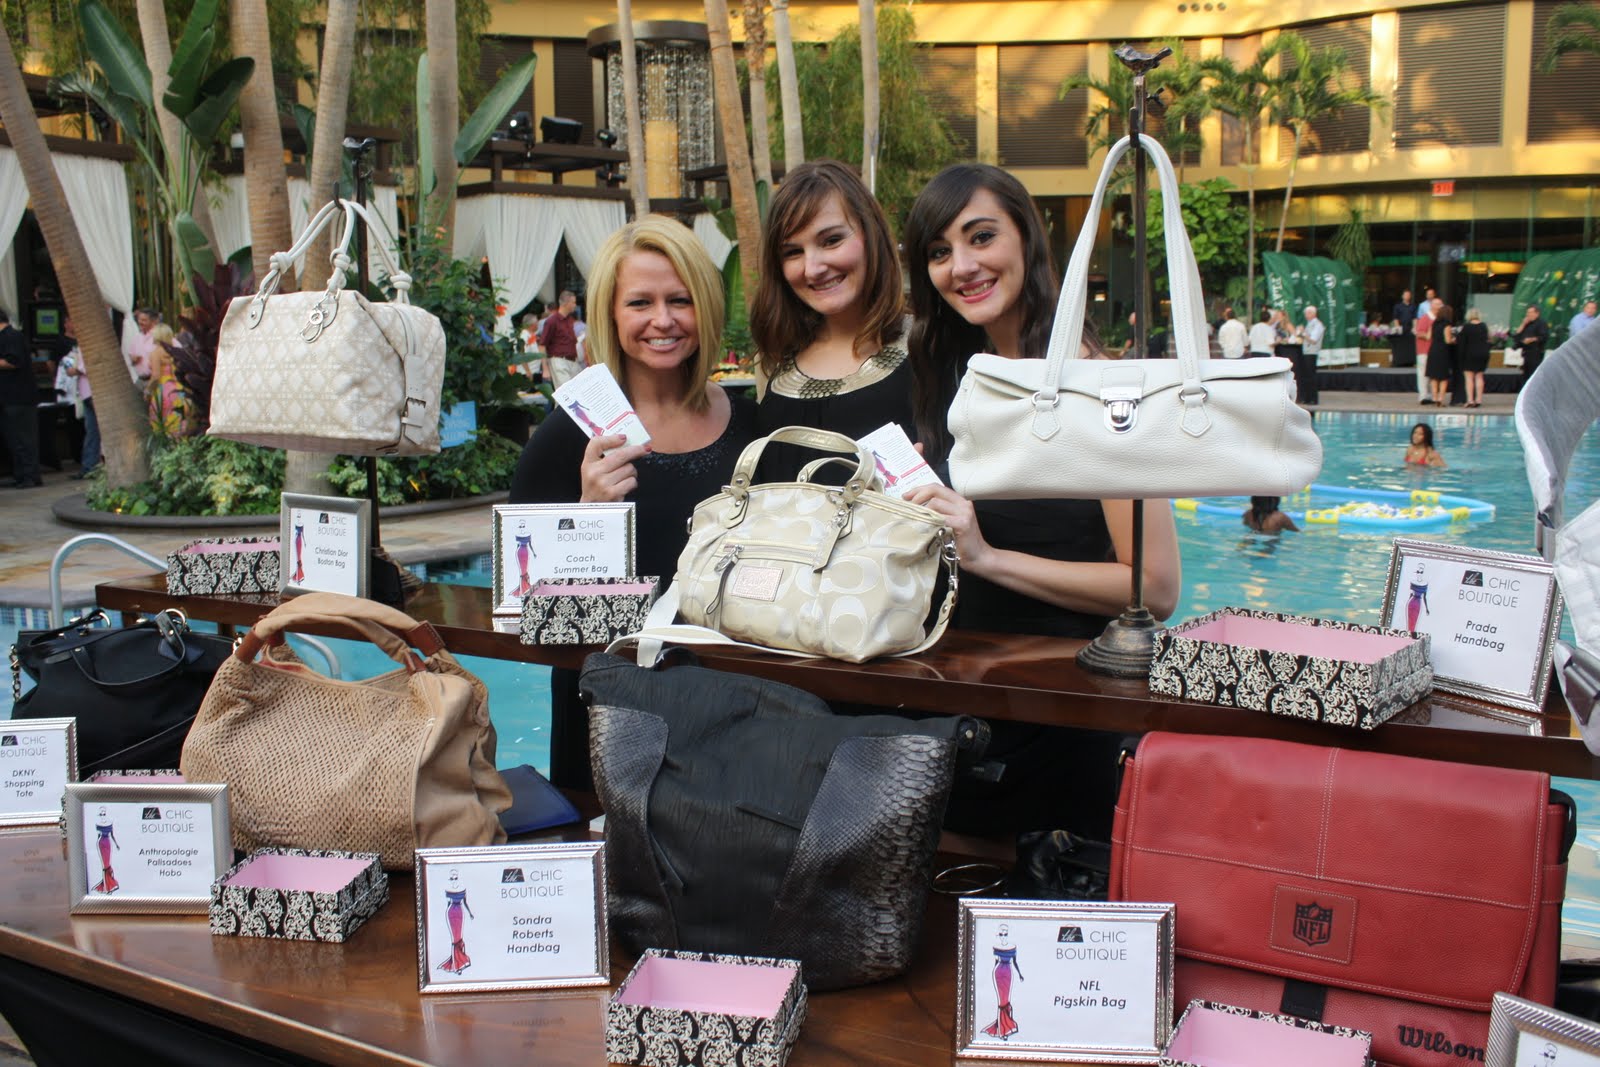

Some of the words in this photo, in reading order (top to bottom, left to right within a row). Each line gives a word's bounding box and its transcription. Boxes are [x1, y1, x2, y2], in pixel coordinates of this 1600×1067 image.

[331, 516, 346, 525] CHIC
[579, 520, 604, 529] CHIC
[318, 527, 346, 537] BOUTIQUE
[557, 532, 605, 542] BOUTIQUE
[315, 547, 336, 556] Christian
[338, 549, 348, 557] Dior
[318, 558, 334, 566] Boston
[335, 560, 345, 569] Bag
[566, 554, 595, 562] Coach
[554, 566, 588, 574] Summer
[591, 565, 608, 574] Bag
[1488, 577, 1520, 592] CHIC
[1458, 589, 1518, 608] BOUTIQUE
[1466, 620, 1497, 634] Prada
[1454, 633, 1505, 652] Handbag
[22, 736, 46, 745] CHIC
[0, 747, 47, 758] BOUTIQUE
[12, 769, 36, 777] DKNY
[5, 779, 44, 788] Shopping
[166, 810, 193, 819] CHIC
[142, 823, 195, 834] BOUTIQUE
[139, 848, 198, 858] Anthropologie
[147, 858, 192, 866] Palisadoes
[159, 869, 182, 877] Hobo
[530, 869, 563, 881] CHIC
[501, 885, 564, 899] BOUTIQUE
[512, 915, 552, 926] Sondra
[512, 929, 554, 939] Roberts
[1297, 918, 1327, 941] NFL
[1089, 930, 1127, 943] CHIC
[507, 943, 561, 954] Handbag
[1056, 948, 1127, 961] BOUTIQUE
[1079, 980, 1101, 991] NFL
[1054, 996, 1097, 1009] Pigskin
[1101, 997, 1126, 1009] Bag
[1397, 1024, 1486, 1062] Wilson
